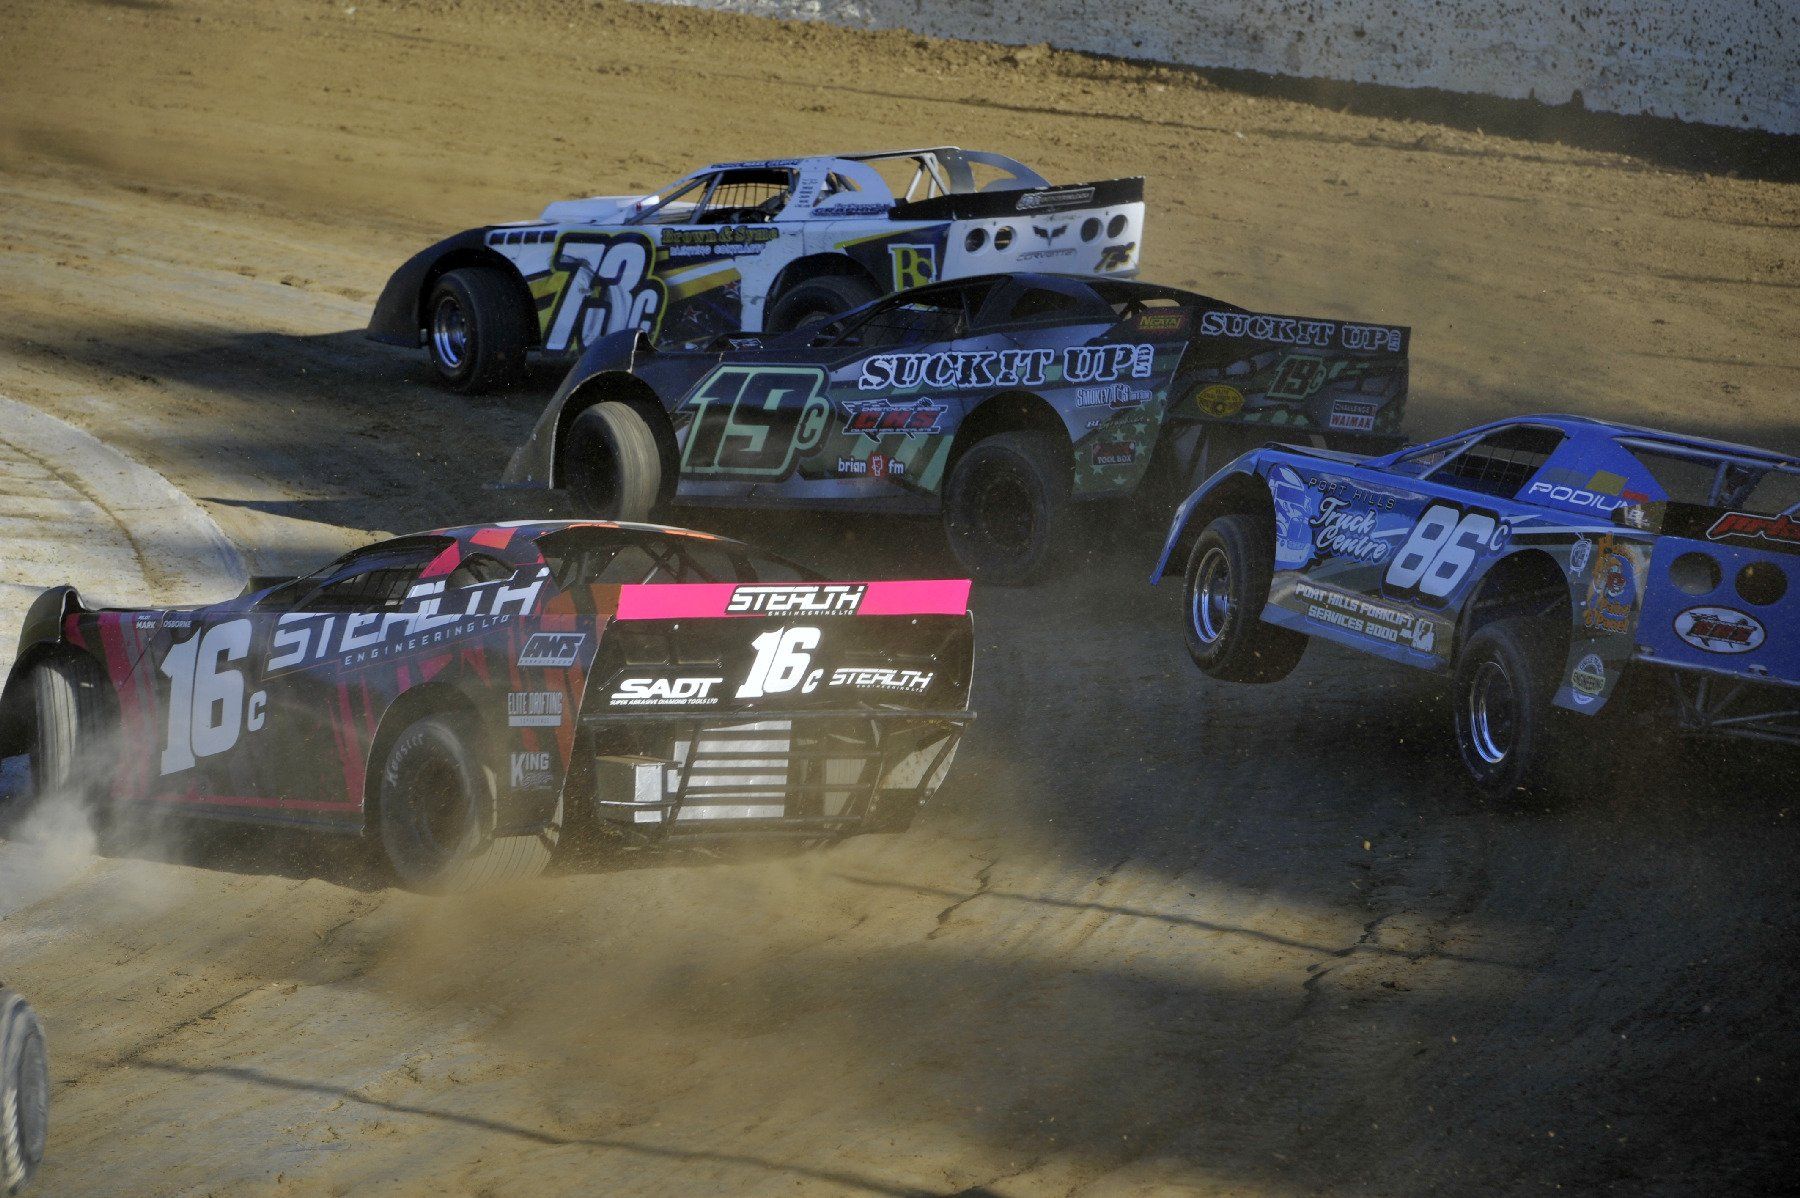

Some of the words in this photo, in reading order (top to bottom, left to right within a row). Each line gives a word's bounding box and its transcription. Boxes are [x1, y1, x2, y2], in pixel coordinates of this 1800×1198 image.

[719, 225, 733, 244] &
[1342, 325, 1389, 351] UP
[1063, 345, 1136, 382] UP
[1076, 388, 1110, 408] SMOKEY
[1331, 414, 1374, 429] WAIMAK
[838, 457, 867, 474] brian
[888, 459, 904, 474] fm
[1117, 454, 1132, 463] BOX
[1308, 477, 1345, 495] PORT
[1353, 489, 1396, 511] HILLS
[1309, 497, 1377, 535] Truck
[1316, 525, 1389, 561] Centre
[727, 585, 864, 611] STEALTH
[1296, 583, 1327, 601] PORT
[1328, 593, 1360, 612] HILLS
[1357, 602, 1413, 628] FORKLIFT
[136, 620, 156, 629] MARK
[163, 619, 192, 628] OSBORNE
[267, 566, 550, 673] STEALTH
[1308, 605, 1364, 632] SERVICES
[1365, 621, 1398, 642] 2000
[344, 622, 476, 667] ENGINEERING
[481, 614, 510, 630] LTD
[611, 678, 723, 699] SADT
[829, 668, 934, 688] STEALTH
[507, 692, 528, 715] ELITE
[529, 692, 563, 714] DRIFTING
[706, 697, 719, 705] LTD
